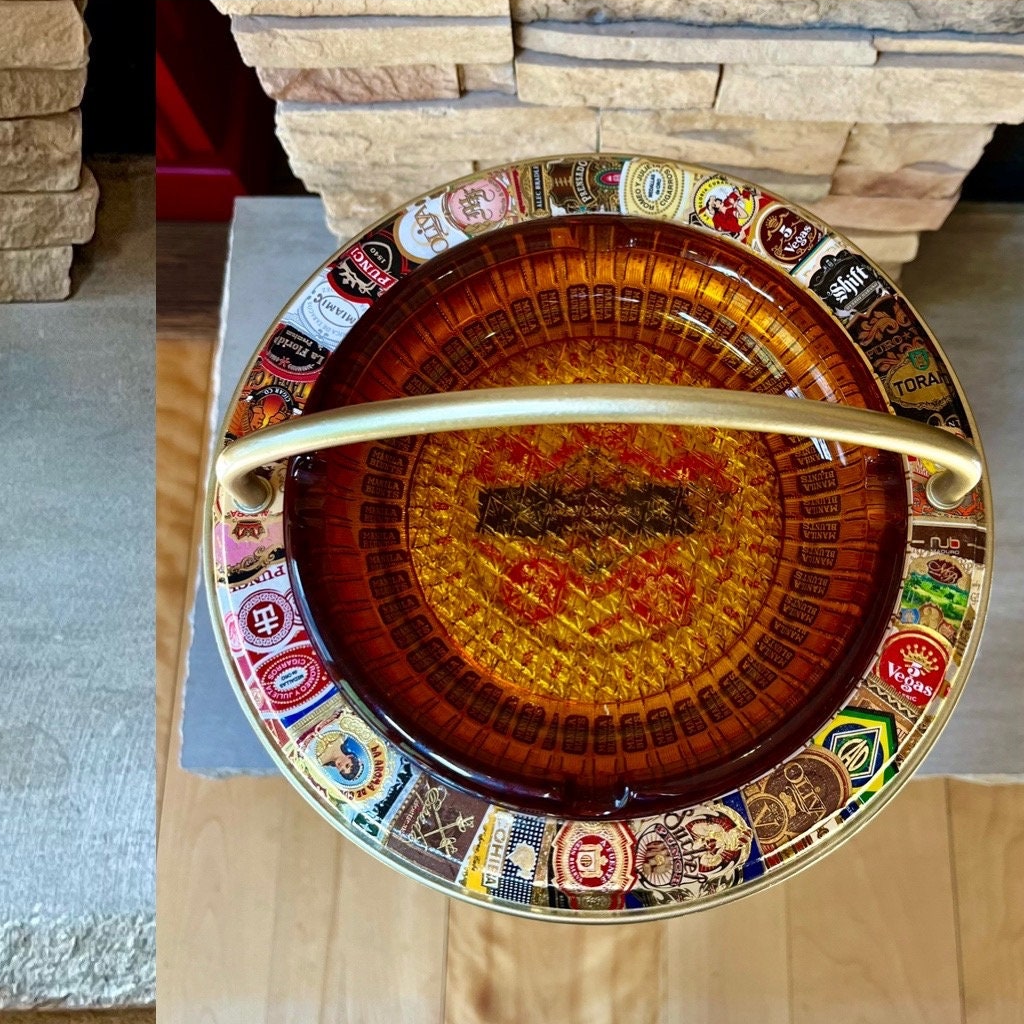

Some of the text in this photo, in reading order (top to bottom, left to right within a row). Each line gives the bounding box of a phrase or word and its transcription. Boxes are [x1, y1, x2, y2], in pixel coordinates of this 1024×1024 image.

[576, 160, 592, 204] PRENSADO
[659, 170, 674, 206] CIGARROS
[632, 188, 655, 211] ROMEO
[414, 204, 449, 254] OLIVA
[780, 224, 794, 238] 5
[784, 225, 812, 253] Vegas
[828, 265, 870, 304] Shift
[320, 296, 358, 324] MIAMI
[930, 536, 960, 550] nub
[266, 658, 306, 680] CIGARROS
[888, 661, 934, 697] Vegas
[906, 662, 923, 678] 5
[784, 762, 826, 822] OLIVA
